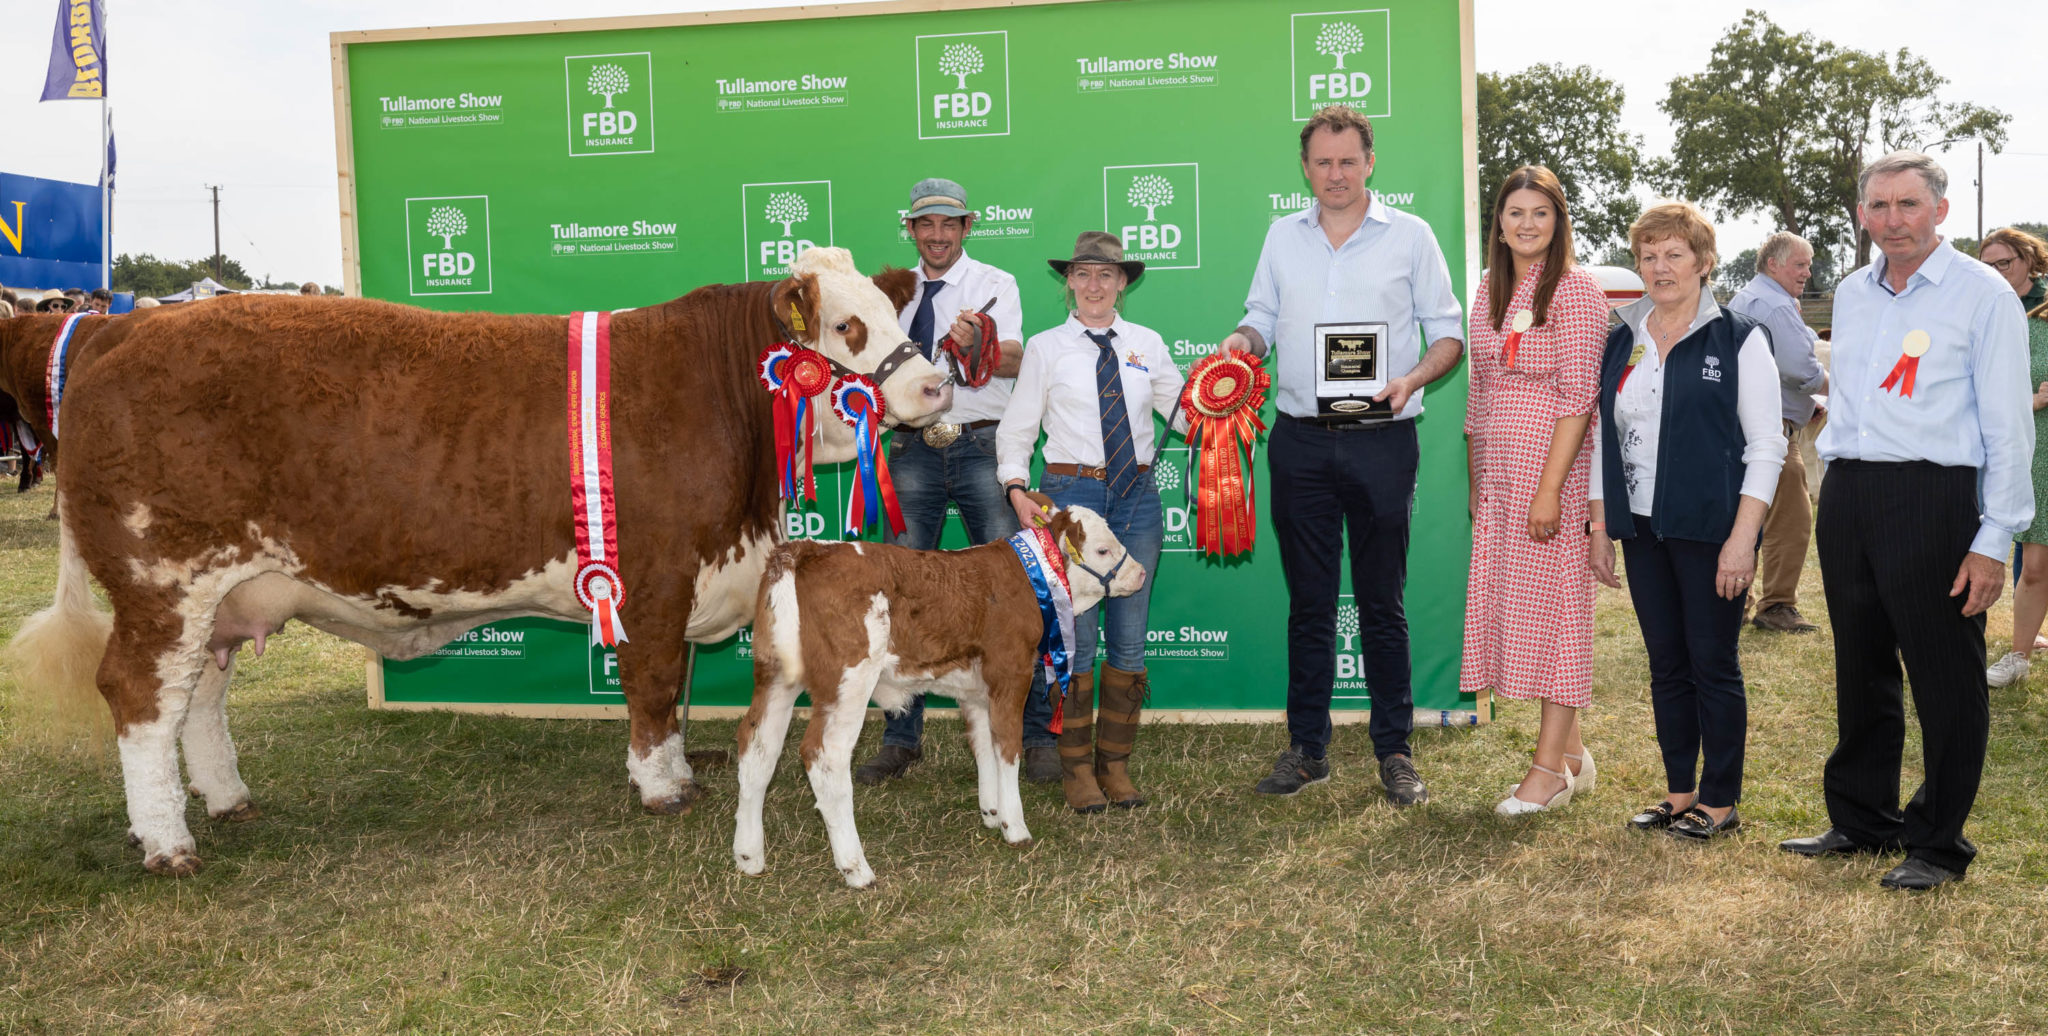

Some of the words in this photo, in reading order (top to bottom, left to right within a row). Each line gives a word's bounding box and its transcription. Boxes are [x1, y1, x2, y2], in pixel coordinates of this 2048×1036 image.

[1076, 56, 1164, 75] Tullamore
[1168, 53, 1218, 70] Show
[716, 78, 797, 95] Tullamore
[801, 74, 848, 90] Show
[1109, 77, 1146, 88] National
[1148, 75, 1188, 86] Livestock
[1190, 74, 1214, 84] Show
[1310, 72, 1372, 100] FBD
[379, 96, 456, 112] Tullamore
[459, 93, 502, 108] Show
[746, 98, 780, 108] National
[782, 96, 820, 106] Livestock
[821, 95, 844, 104] Show
[934, 92, 992, 119] FBD
[408, 116, 440, 125] National
[441, 114, 477, 124] Livestock
[478, 113, 499, 122] Show
[583, 110, 637, 136] FBD
[936, 119, 988, 129] INSURANCE
[585, 137, 633, 146] INSURANCE
[1268, 193, 1319, 210] Tulla
[1373, 190, 1414, 205] how
[986, 205, 1033, 221] Show
[550, 223, 628, 239] Tullamore
[632, 220, 677, 236] Show
[1006, 227, 1029, 235] Show
[1121, 224, 1182, 250] FBD
[580, 243, 612, 252] National
[614, 241, 650, 251] Livestock
[652, 240, 674, 249] Show
[1124, 252, 1177, 261] INSURANCE
[423, 252, 476, 276] FBD
[763, 267, 791, 275] INSUR
[426, 277, 472, 287] INSURANCE
[1702, 368, 1721, 378] FBD
[787, 513, 825, 536] BD
[482, 628, 524, 642] Show
[1179, 626, 1228, 642] Show
[464, 648, 499, 656] Livestock
[501, 648, 521, 656] Show
[1160, 648, 1199, 656] Livestock
[1200, 648, 1224, 657] Show
